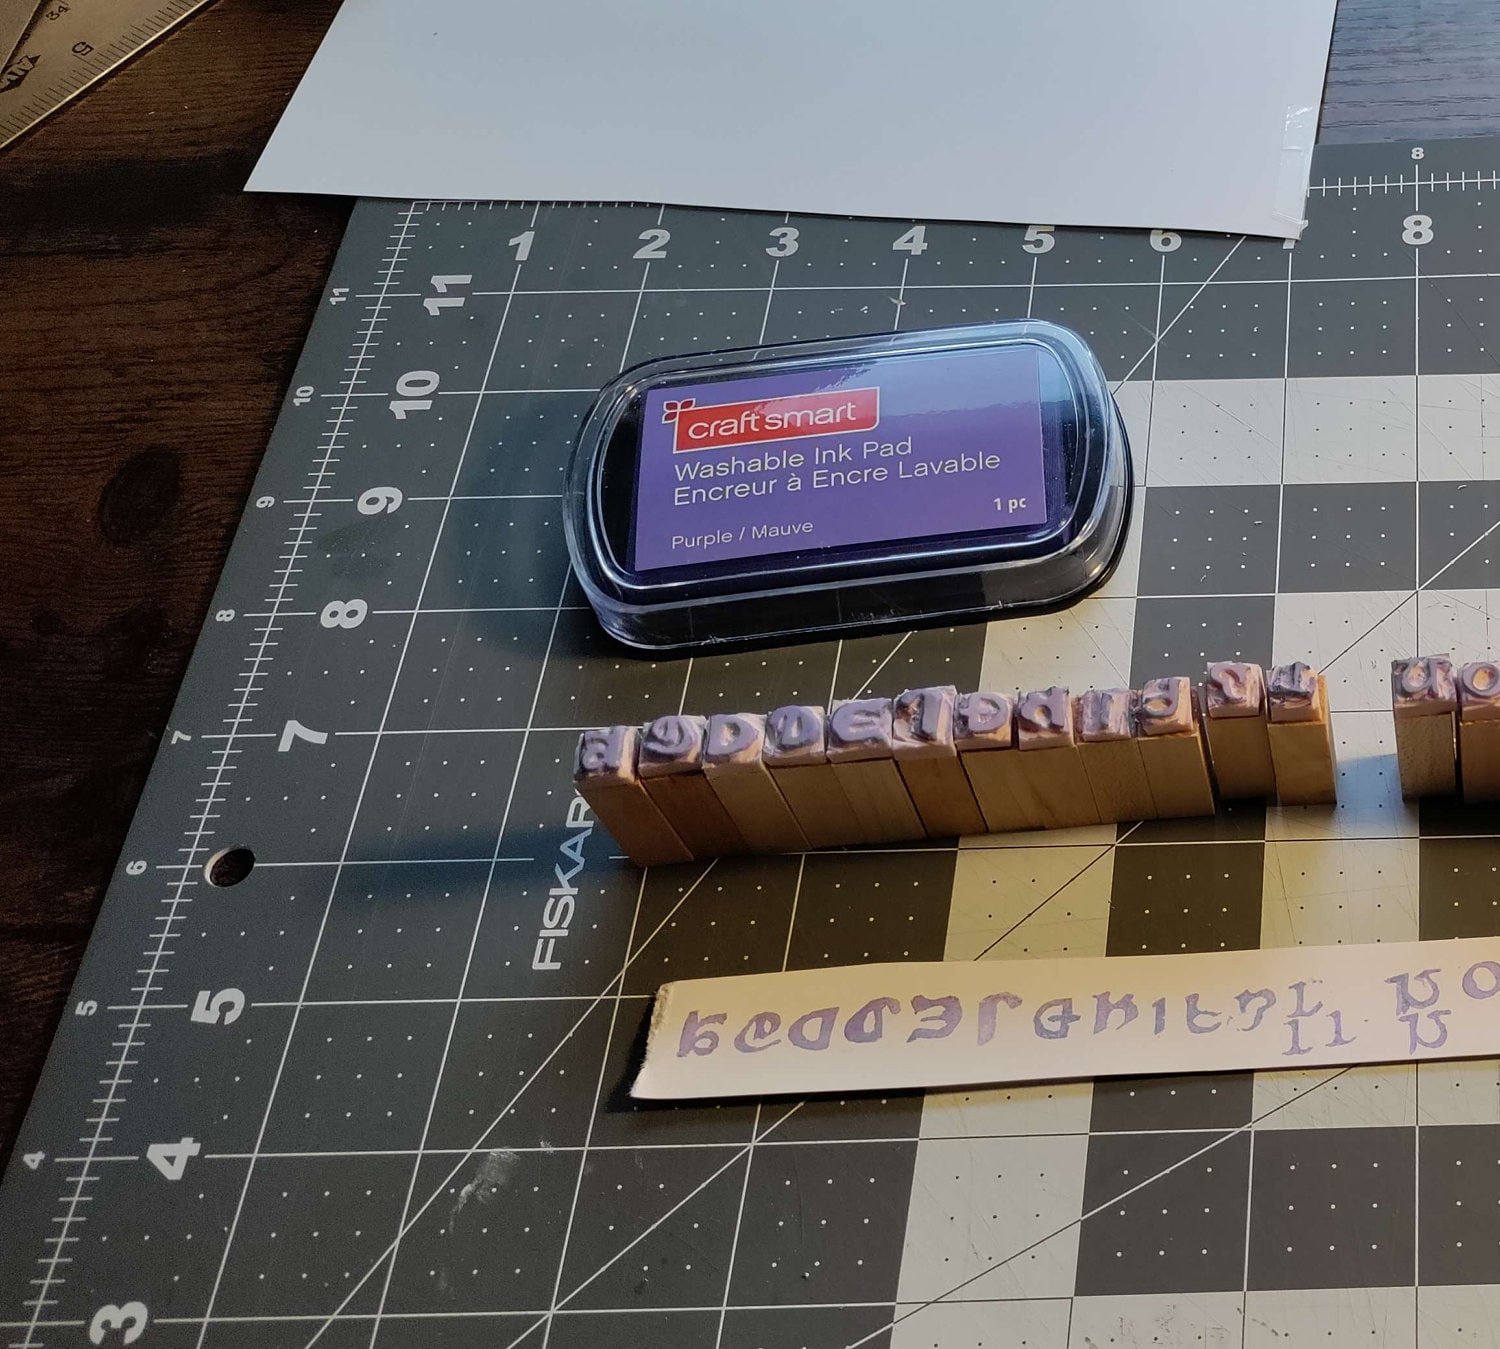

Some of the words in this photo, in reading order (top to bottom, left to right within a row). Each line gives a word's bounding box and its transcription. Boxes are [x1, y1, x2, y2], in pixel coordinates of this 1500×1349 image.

[1411, 148, 1425, 160] 8
[633, 230, 672, 259] 2
[766, 228, 800, 257] 3
[893, 226, 928, 255] 4
[1022, 225, 1057, 254] 5
[1149, 228, 1183, 253] 6
[1402, 214, 1435, 246] 8
[507, 232, 537, 261] 1
[329, 286, 350, 305] 11
[423, 273, 473, 315] 11
[293, 385, 315, 407] 10
[389, 370, 440, 419] 10
[688, 410, 760, 440] craft
[765, 401, 857, 432] smart
[674, 449, 804, 482] Washable
[815, 443, 853, 464] Ink
[864, 436, 912, 459] Pad
[674, 479, 777, 506] Encreur
[788, 469, 802, 491] à
[813, 466, 888, 489] Encre
[899, 451, 1001, 479] Lavable
[256, 496, 275, 510] 9
[357, 487, 403, 515] 9
[993, 498, 1003, 512] 1
[1008, 497, 1027, 515] pc
[672, 529, 733, 551] Purple
[752, 520, 814, 540] Mauve
[215, 609, 236, 623] 8
[320, 598, 368, 630] 8
[170, 731, 192, 745] 7
[277, 720, 328, 752] 7
[125, 860, 148, 875] 6
[531, 790, 596, 971] FISKAR
[75, 1000, 98, 1016] 5
[190, 988, 246, 1025] 5
[22, 1152, 47, 1169] 4
[145, 1136, 202, 1180] 4
[88, 1301, 149, 1346] 3
